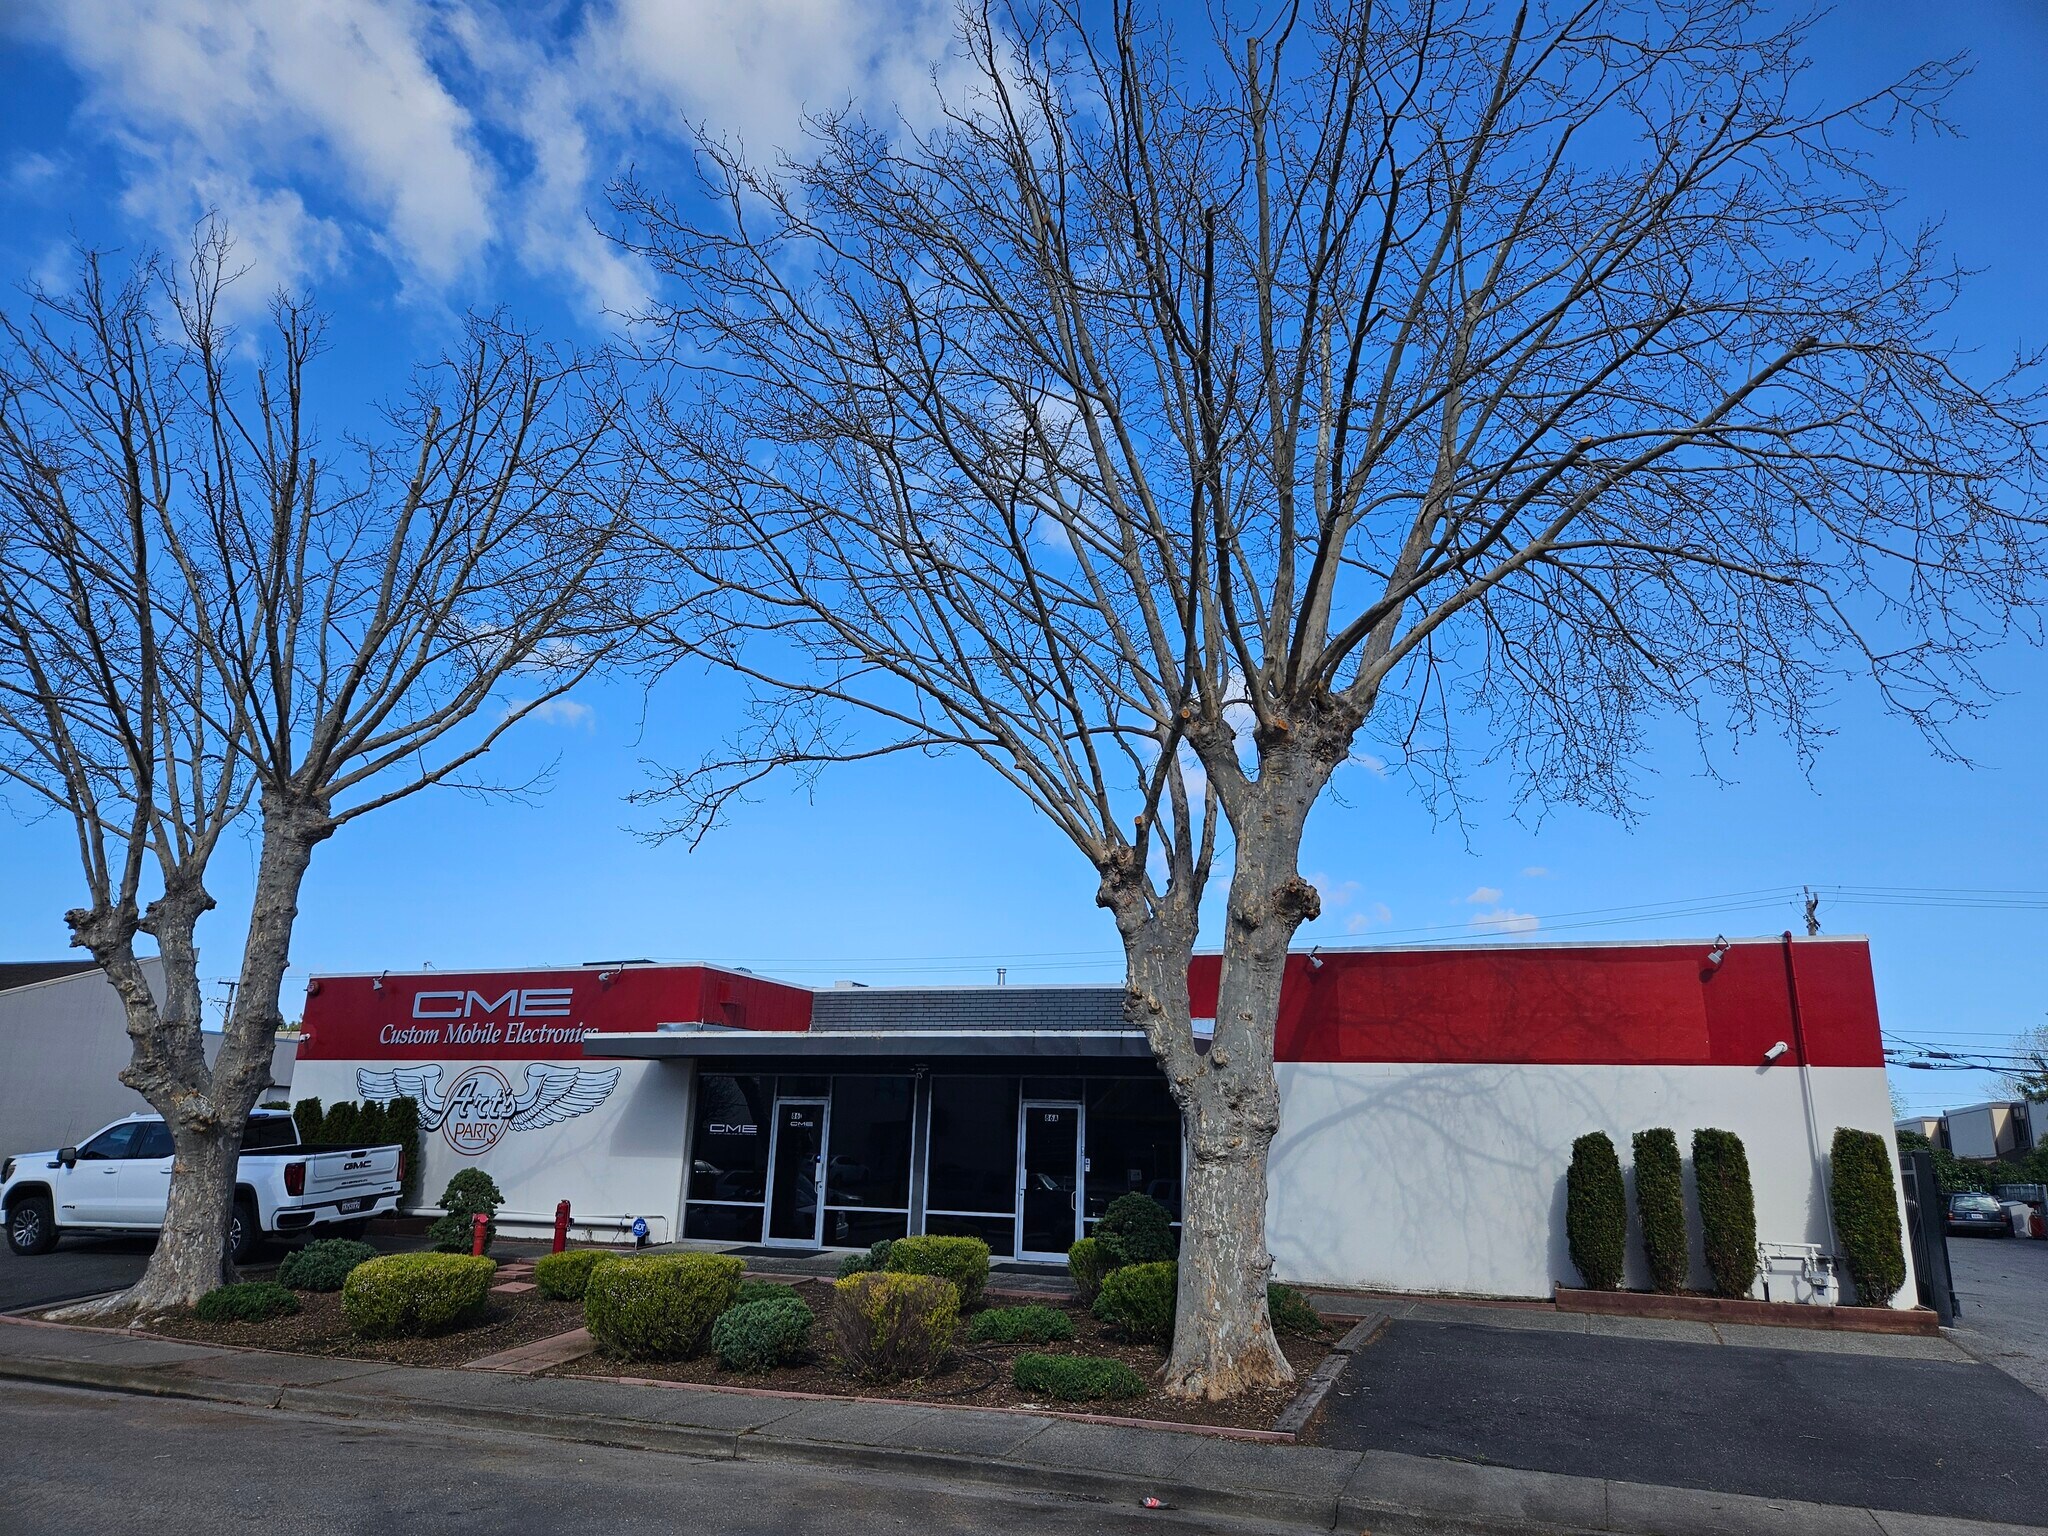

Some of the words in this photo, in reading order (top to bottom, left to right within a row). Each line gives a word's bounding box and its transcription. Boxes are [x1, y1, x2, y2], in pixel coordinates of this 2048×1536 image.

[412, 988, 574, 1018] CME
[379, 1023, 440, 1045] Custom
[443, 1021, 501, 1045] Mobile
[432, 1077, 517, 1129] Art's
[453, 1122, 498, 1144] PARTS
[709, 1123, 758, 1133] CME
[343, 1160, 372, 1171] GMC
